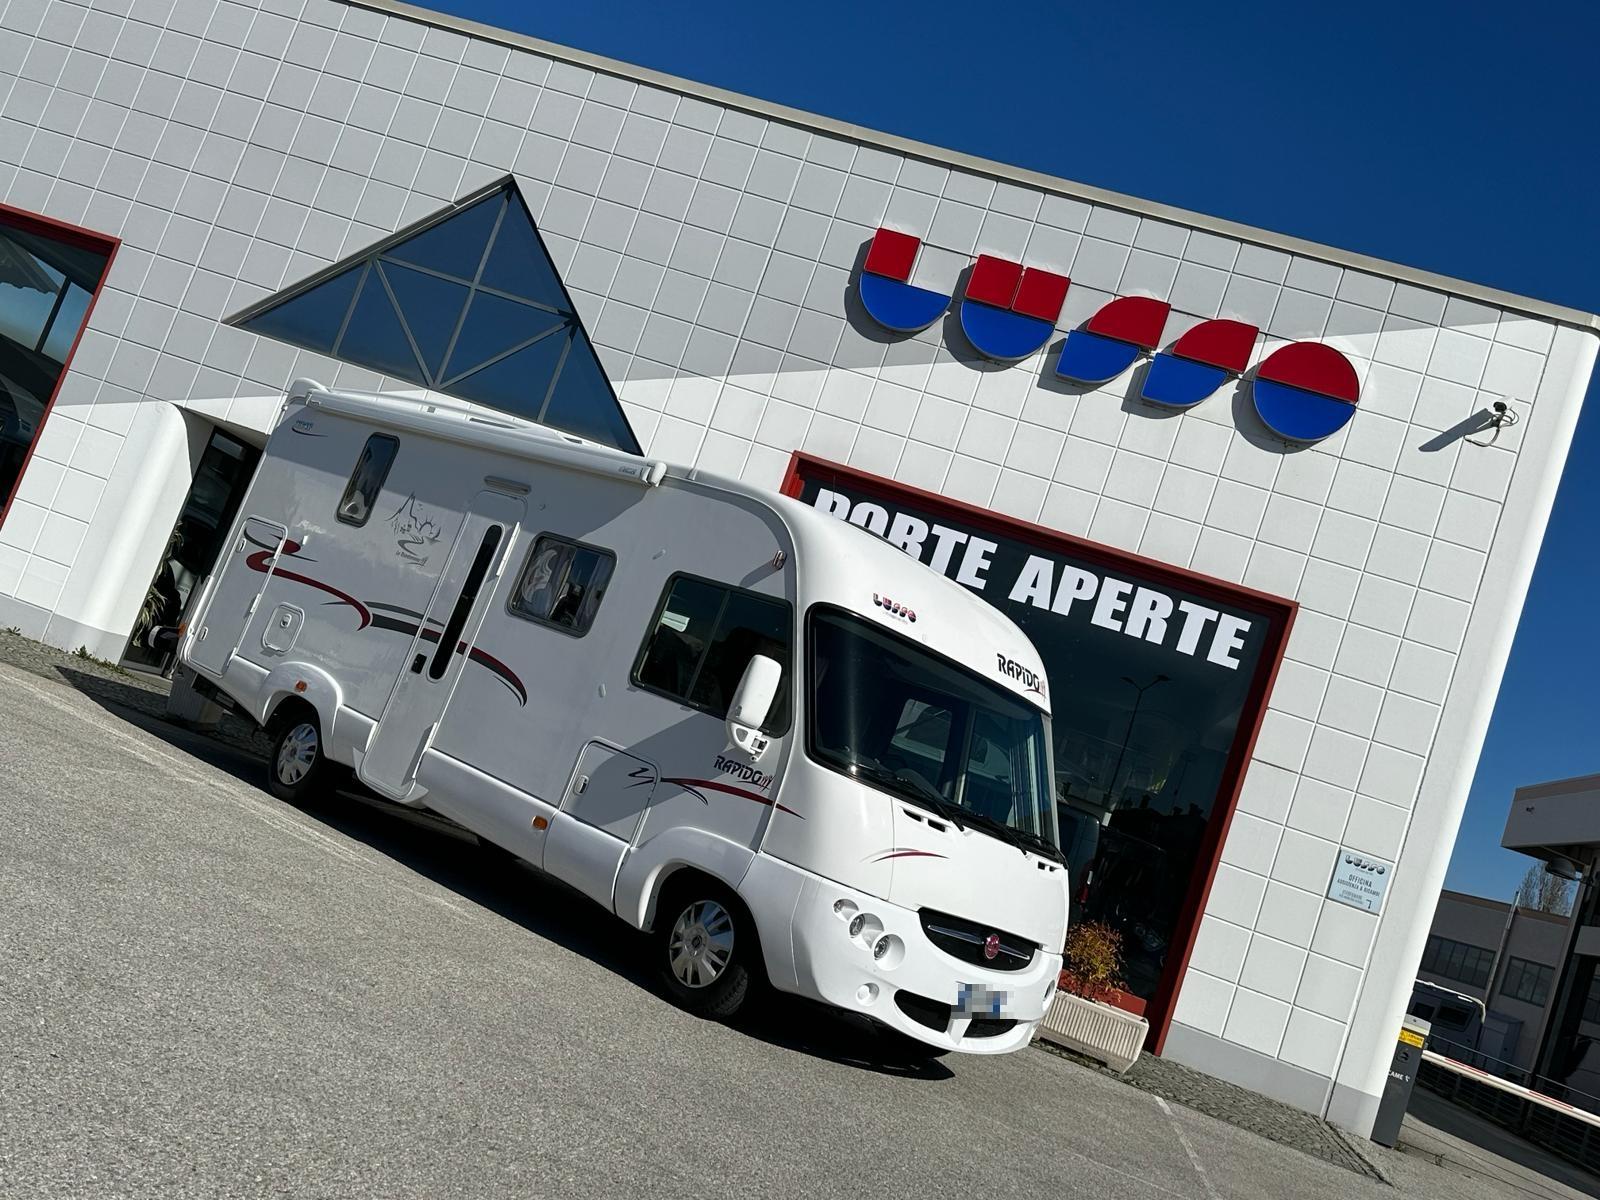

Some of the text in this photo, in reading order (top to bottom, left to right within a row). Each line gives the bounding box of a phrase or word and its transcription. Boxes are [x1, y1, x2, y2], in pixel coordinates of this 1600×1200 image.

[860, 228, 1360, 442] LUSSO
[873, 592, 917, 623] LUSSO
[1008, 554, 1252, 670] APERTE
[1348, 874, 1372, 888] OFFICINA
